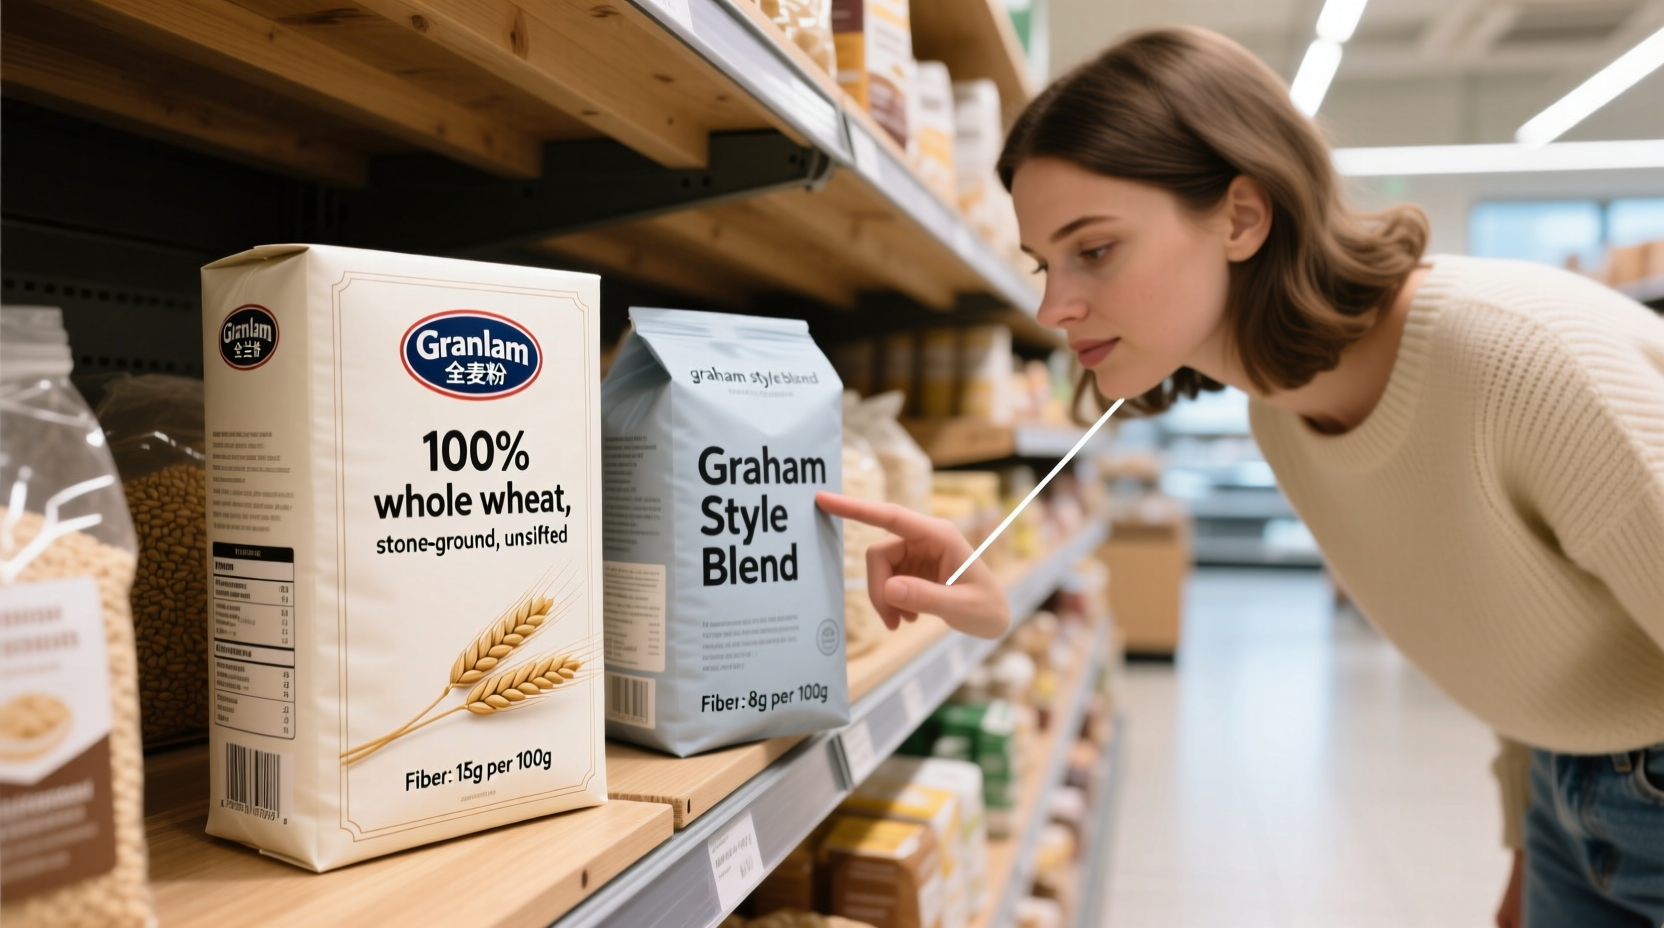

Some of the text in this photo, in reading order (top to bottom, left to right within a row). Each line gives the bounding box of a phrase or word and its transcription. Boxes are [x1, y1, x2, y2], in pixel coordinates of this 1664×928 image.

[416, 329, 529, 367] Granlam
[444, 360, 508, 386] 全麦粉
[690, 367, 746, 384] graham
[423, 430, 530, 472] 100%
[697, 445, 827, 485] Graham
[374, 480, 571, 519] whole wheat,
[700, 494, 789, 546] Style
[376, 527, 500, 557] stone-ground,
[703, 542, 799, 587] Blend
[748, 690, 768, 713] 8g
[771, 690, 795, 711] per
[798, 682, 828, 704] 100g
[405, 748, 552, 792] Fiber: 15g per 100g
